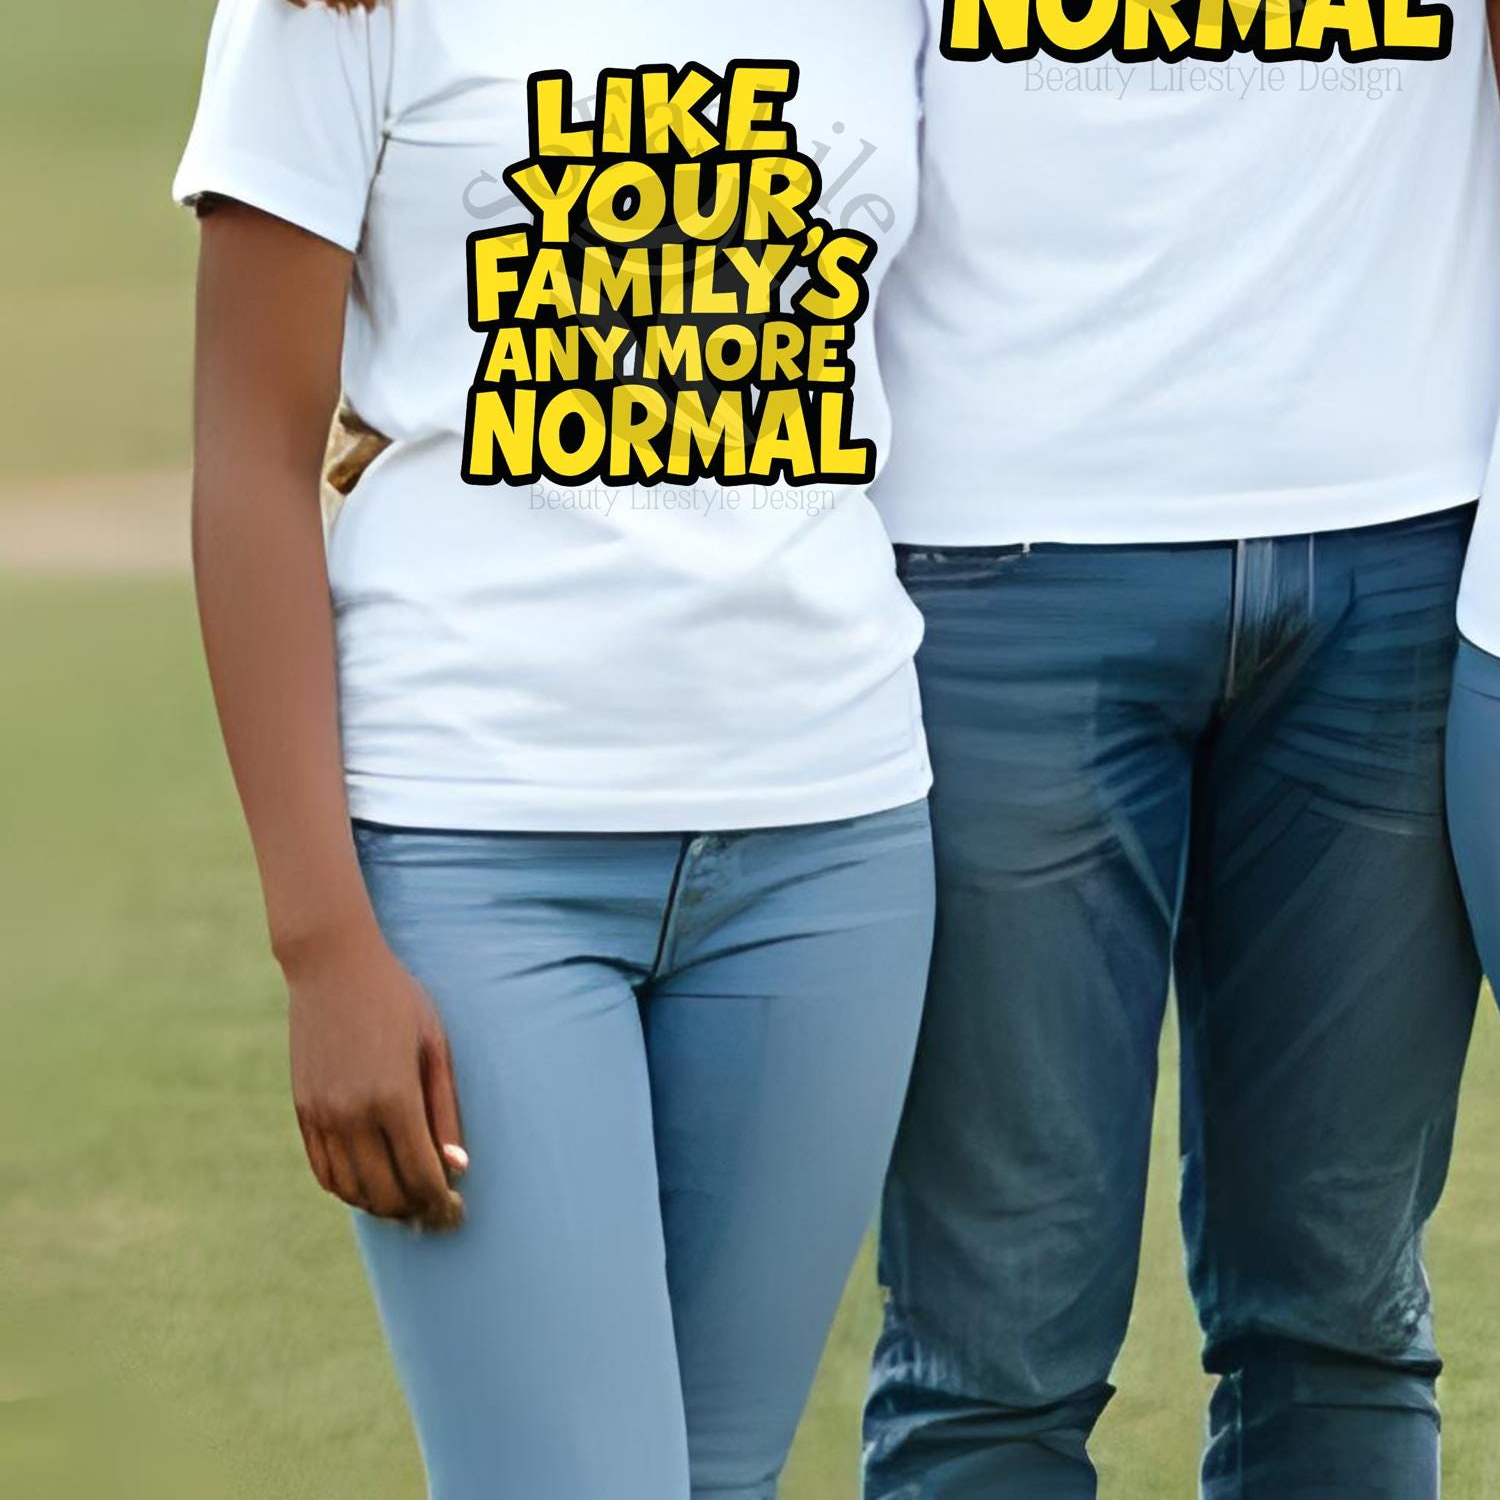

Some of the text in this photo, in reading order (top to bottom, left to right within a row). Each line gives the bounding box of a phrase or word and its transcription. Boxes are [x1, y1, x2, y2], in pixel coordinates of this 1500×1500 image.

[533, 64, 793, 161] LIKE
[509, 153, 816, 246] YOUR
[472, 223, 871, 325] FAMILY'S
[481, 318, 849, 386] ANY MORE
[466, 381, 870, 481] NORMAL
